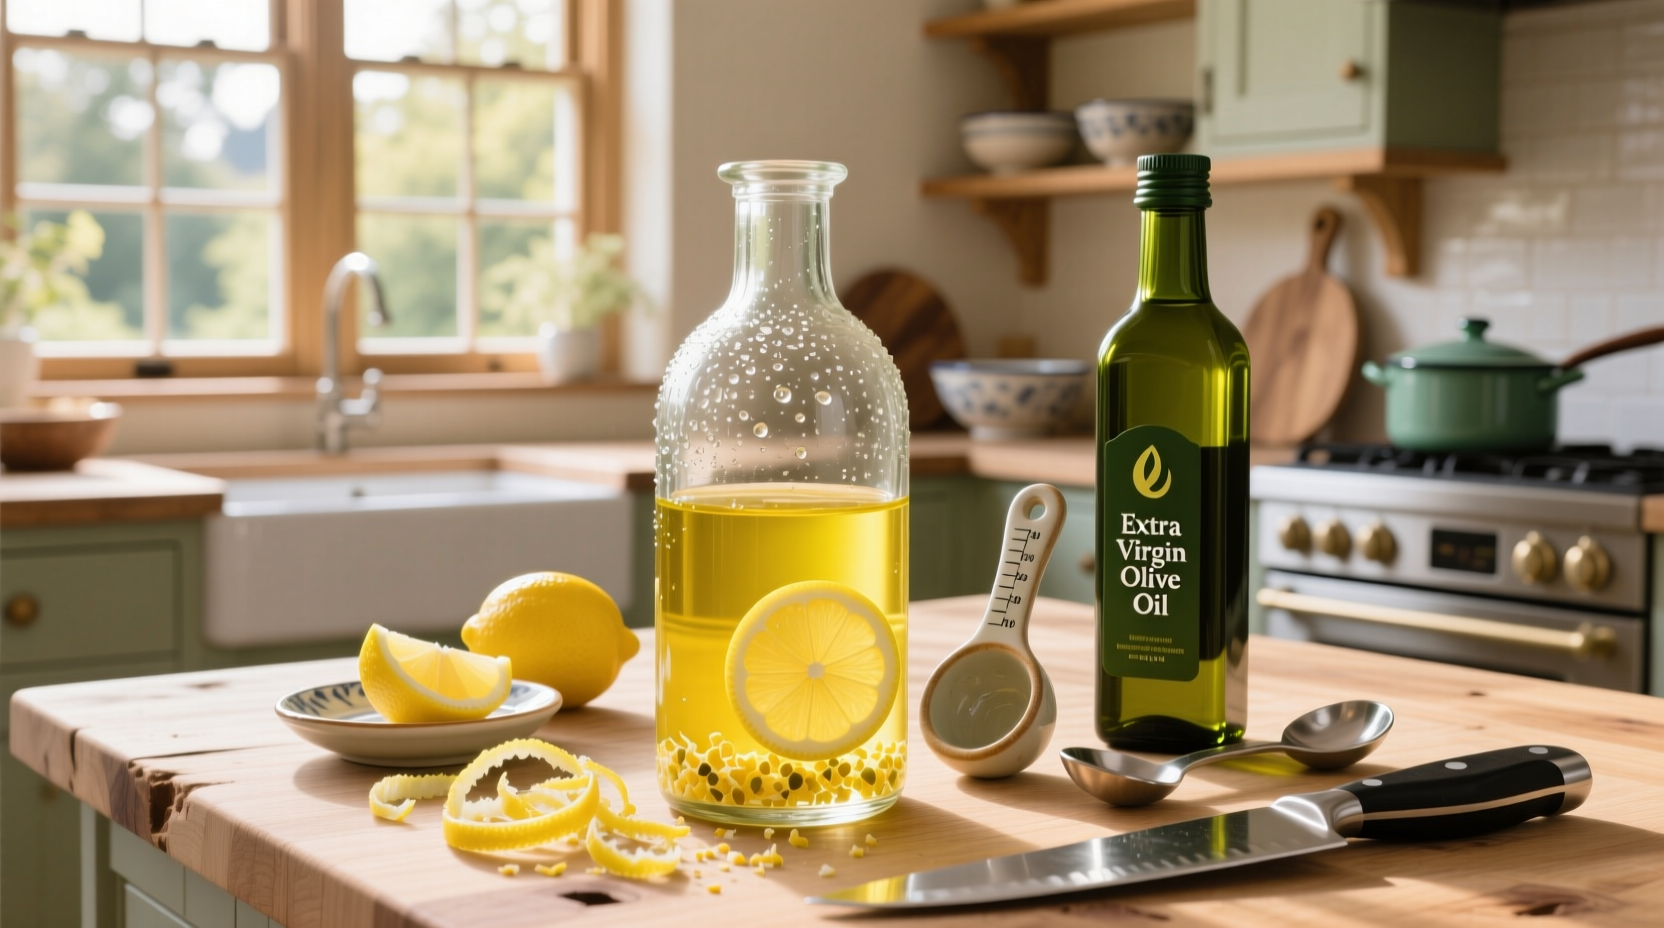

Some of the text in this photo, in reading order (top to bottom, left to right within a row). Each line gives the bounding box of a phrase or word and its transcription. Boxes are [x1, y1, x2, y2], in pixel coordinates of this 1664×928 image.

[1121, 513, 1182, 537] Extra
[1116, 539, 1186, 568] Virgin
[1120, 566, 1181, 590] Olive
[1133, 593, 1169, 616] Oil
